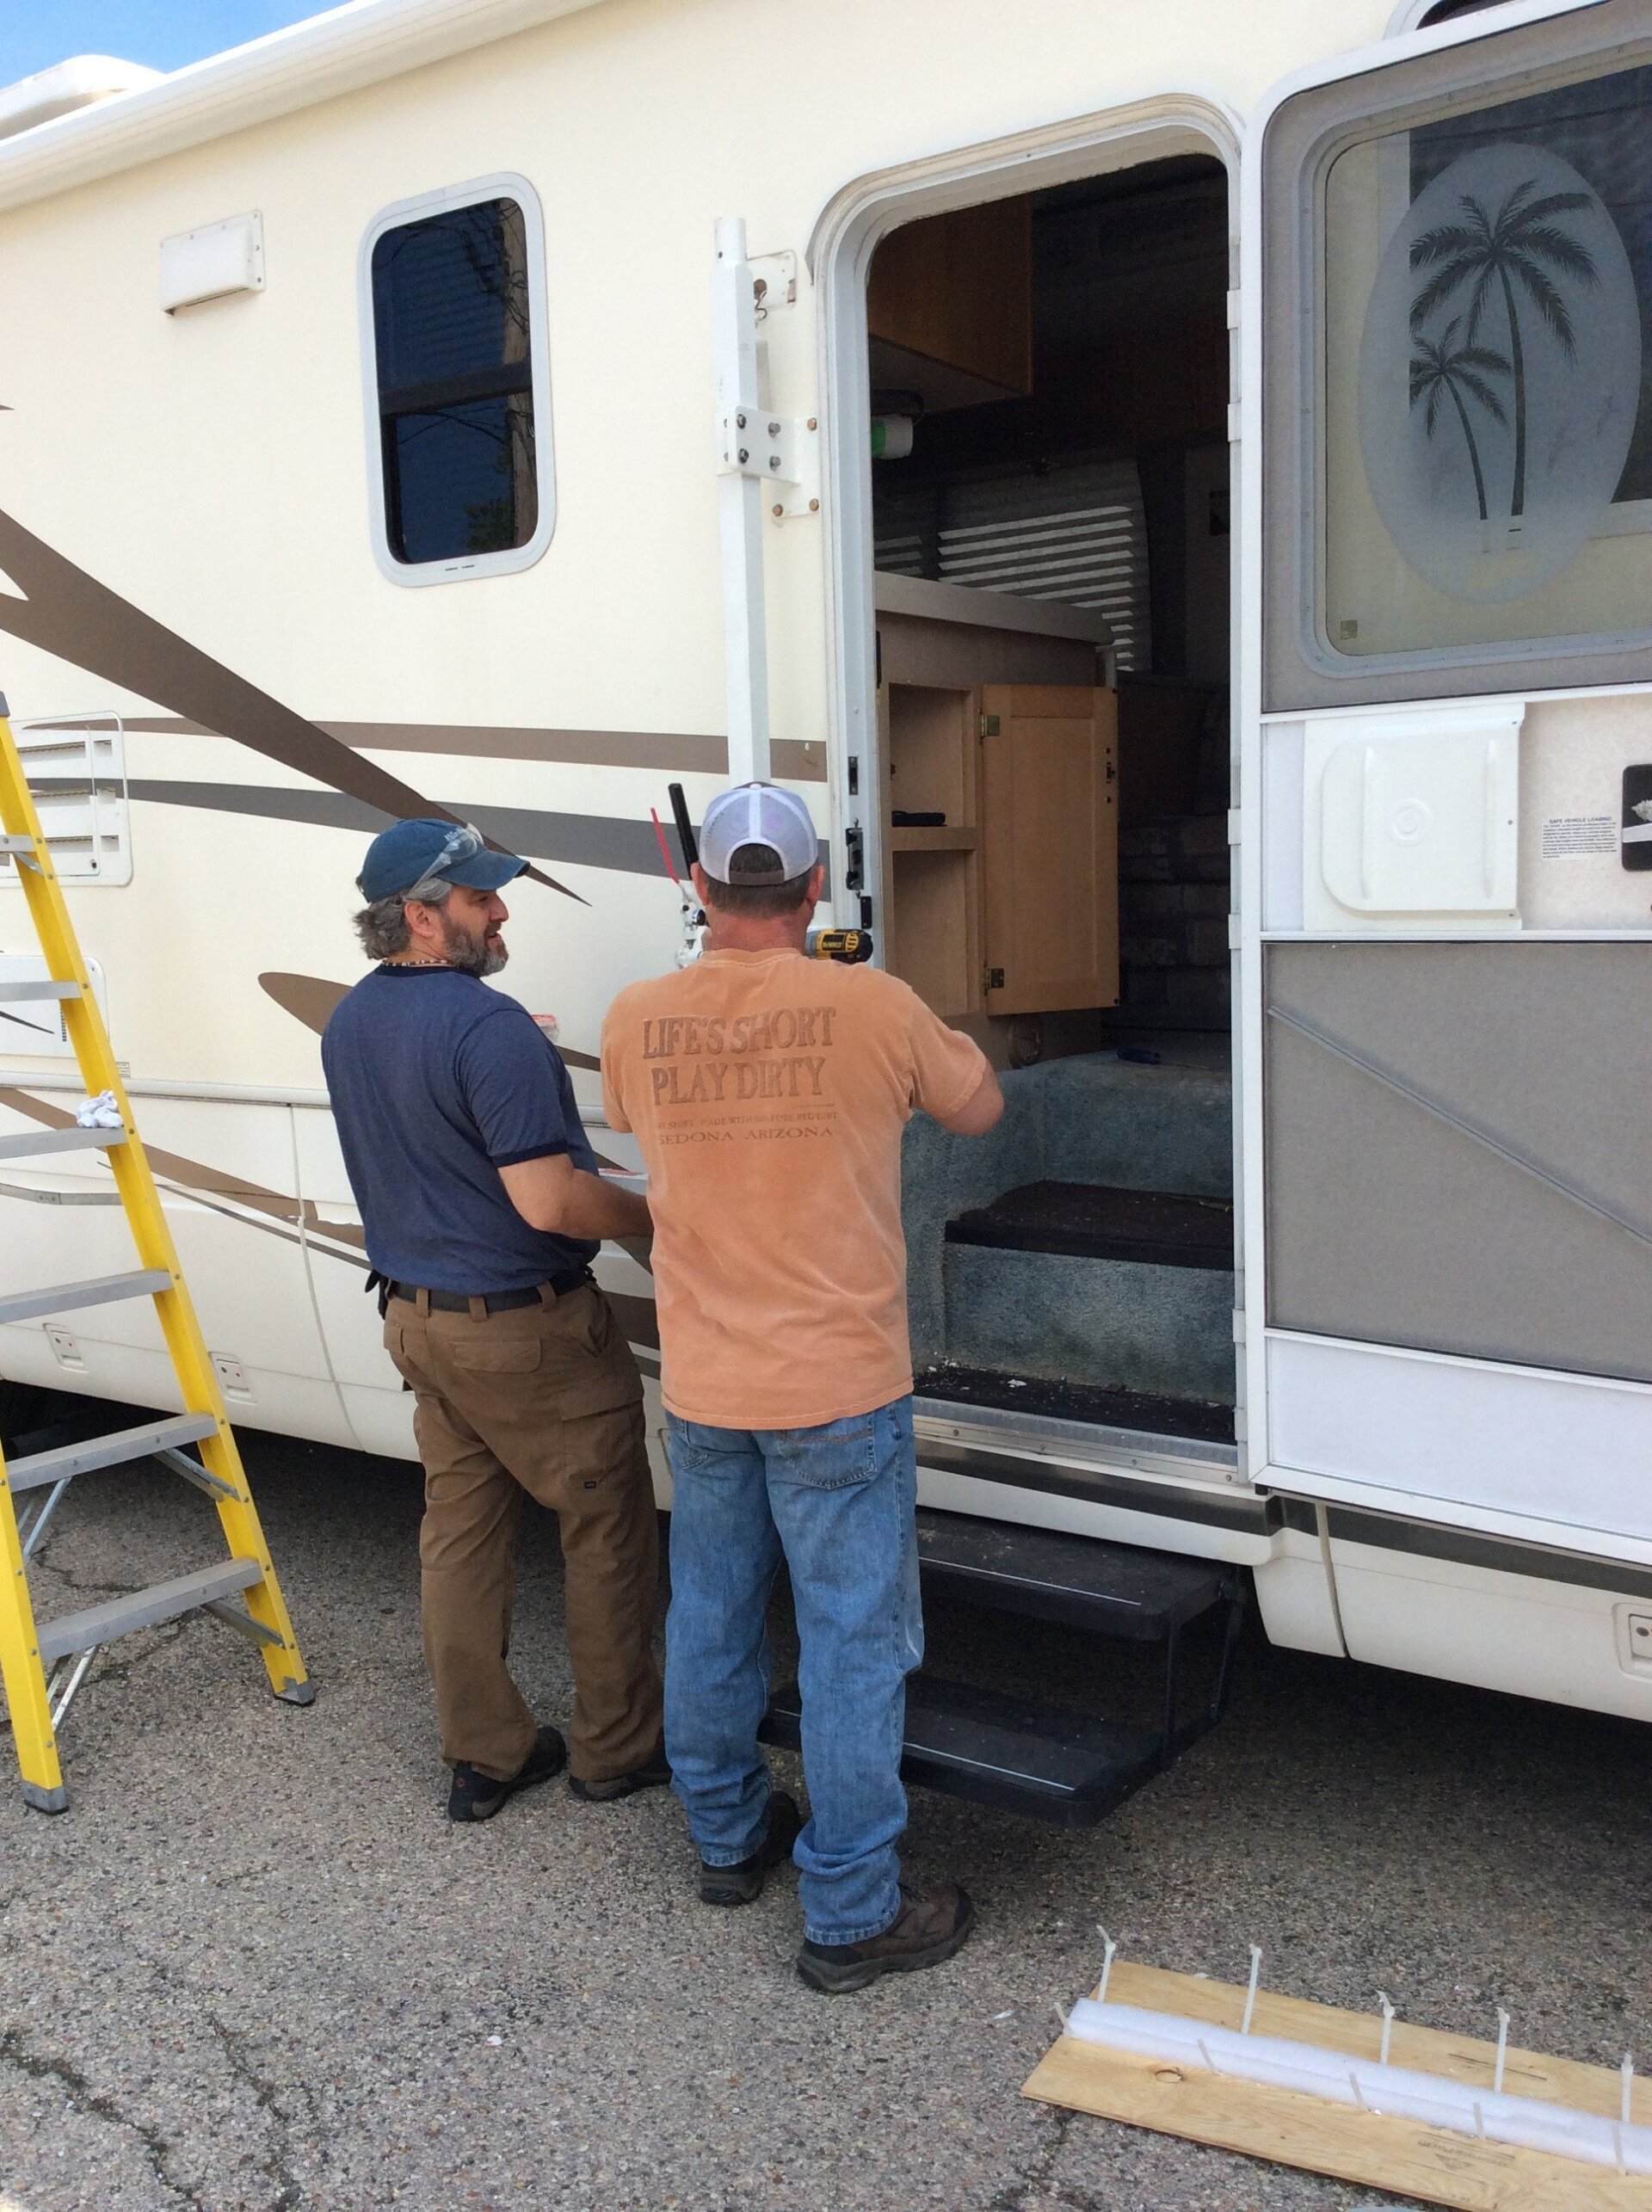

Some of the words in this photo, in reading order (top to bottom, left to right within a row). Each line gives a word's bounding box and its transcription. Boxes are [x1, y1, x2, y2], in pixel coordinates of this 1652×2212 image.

[643, 1015, 726, 1059] LIFE'S
[731, 1006, 836, 1054] SHORT
[651, 1060, 728, 1106] PLAY
[734, 1056, 827, 1100] DIRTY
[659, 1131, 734, 1145] SEDONA
[744, 1126, 832, 1141] ARIZONA
